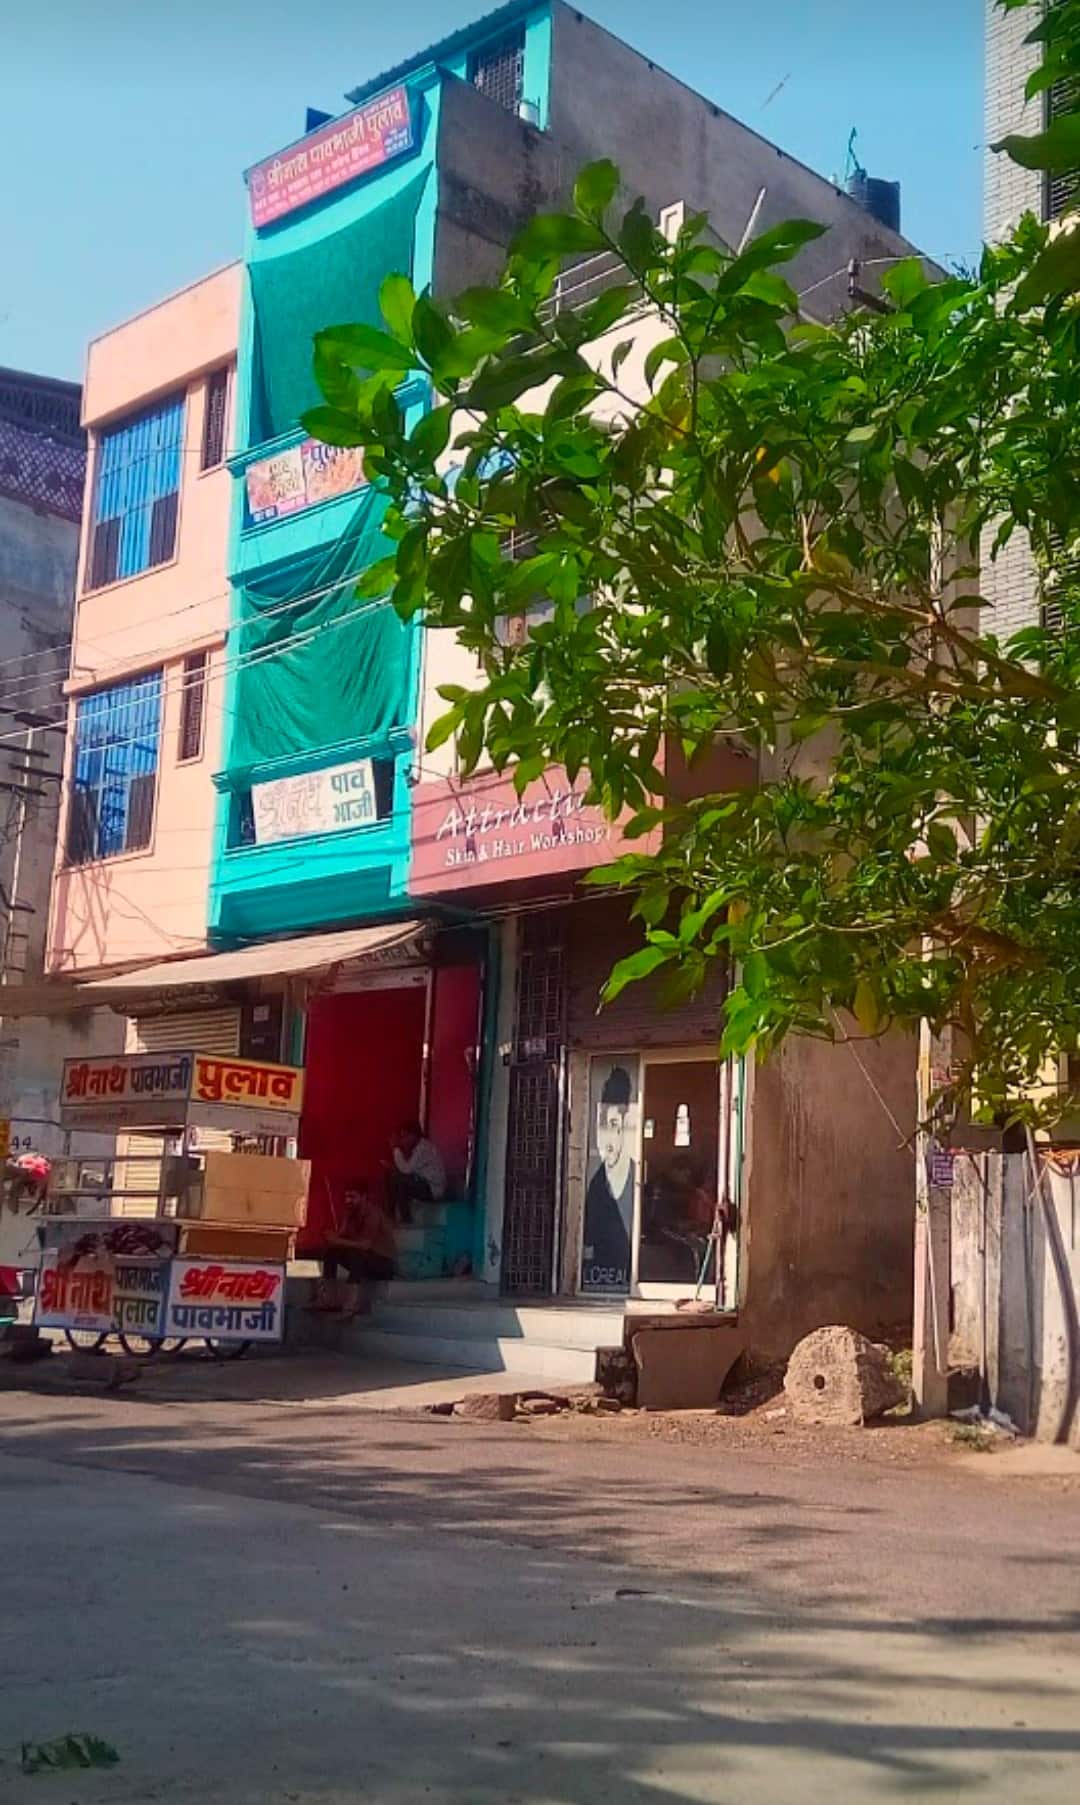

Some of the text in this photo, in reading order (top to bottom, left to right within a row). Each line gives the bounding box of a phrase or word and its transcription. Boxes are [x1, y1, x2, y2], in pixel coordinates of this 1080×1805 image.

[331, 769, 366, 794] पाव
[334, 790, 374, 823] भाजी
[446, 847, 476, 867] Skin
[479, 844, 489, 861] &
[493, 839, 526, 858] Hair
[67, 1057, 191, 1097] श्रीनाथ पावभाजी
[196, 1059, 297, 1100] पुलाव
[180, 1265, 281, 1301] श्रीनाथ
[171, 1301, 277, 1331] पावभाजी
